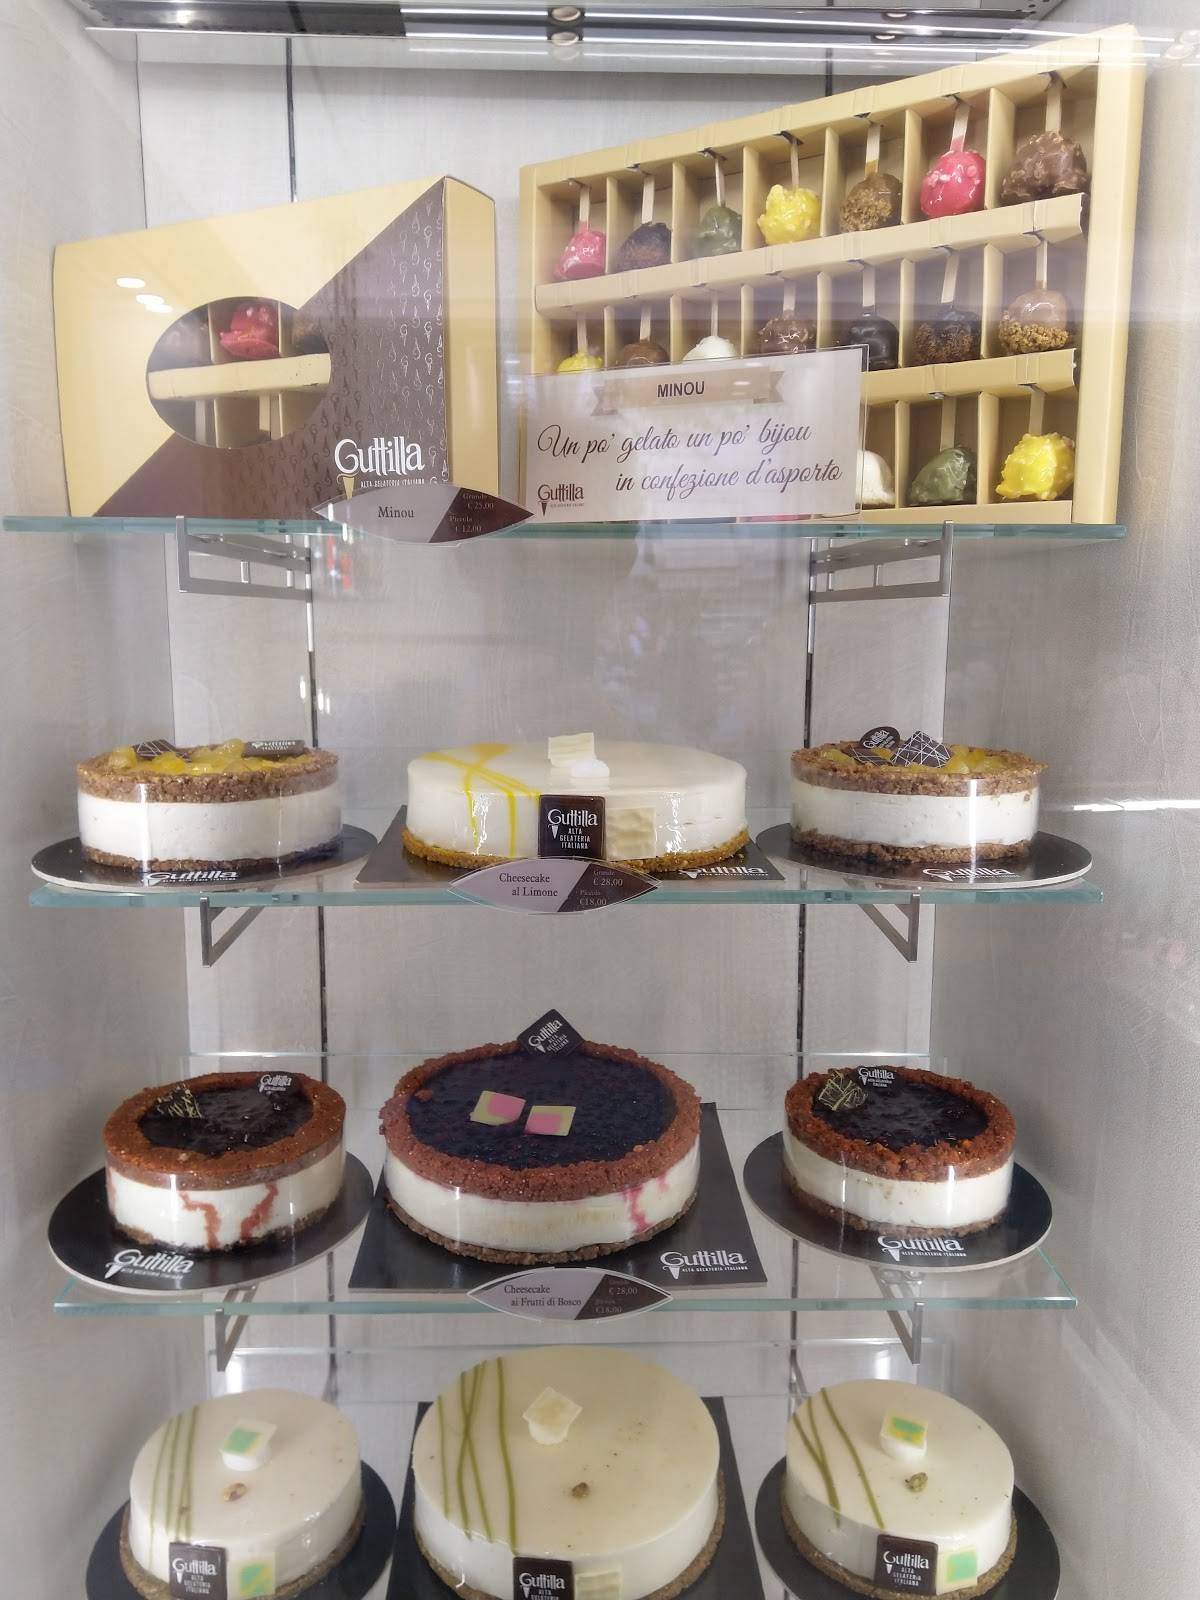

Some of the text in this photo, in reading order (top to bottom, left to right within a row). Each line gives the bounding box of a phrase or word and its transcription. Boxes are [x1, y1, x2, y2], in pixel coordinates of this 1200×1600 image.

[657, 381, 705, 398] MINOU
[537, 424, 580, 458] Un
[616, 425, 681, 464] gelato
[686, 432, 713, 448] un
[758, 418, 812, 455] bijou
[334, 436, 426, 476] Guttilla
[615, 473, 635, 491] in
[640, 463, 740, 501] confezione
[537, 484, 584, 502] Guttilla
[378, 506, 415, 518] Minou
[547, 808, 598, 828] Guttilla
[560, 835, 591, 843] GELATERIA
[568, 827, 583, 835] ALTA
[561, 842, 588, 850] ITALIANA
[499, 873, 550, 883] Cheesecake
[511, 887, 558, 897] al Limone
[528, 1019, 563, 1047] Guttilla
[859, 1067, 895, 1080] Guttilla
[877, 1236, 964, 1252] Guttilla
[114, 1249, 194, 1274] Guttilla
[660, 1250, 747, 1267] Guttilla
[504, 1285, 550, 1294] Cheesecake
[521, 1297, 545, 1307] Frutti
[546, 1297, 555, 1306] di
[557, 1297, 582, 1306] Bosco
[172, 1558, 218, 1576] Guttilla
[883, 1551, 929, 1569] Guttilla
[519, 1573, 566, 1590] Guttilla
